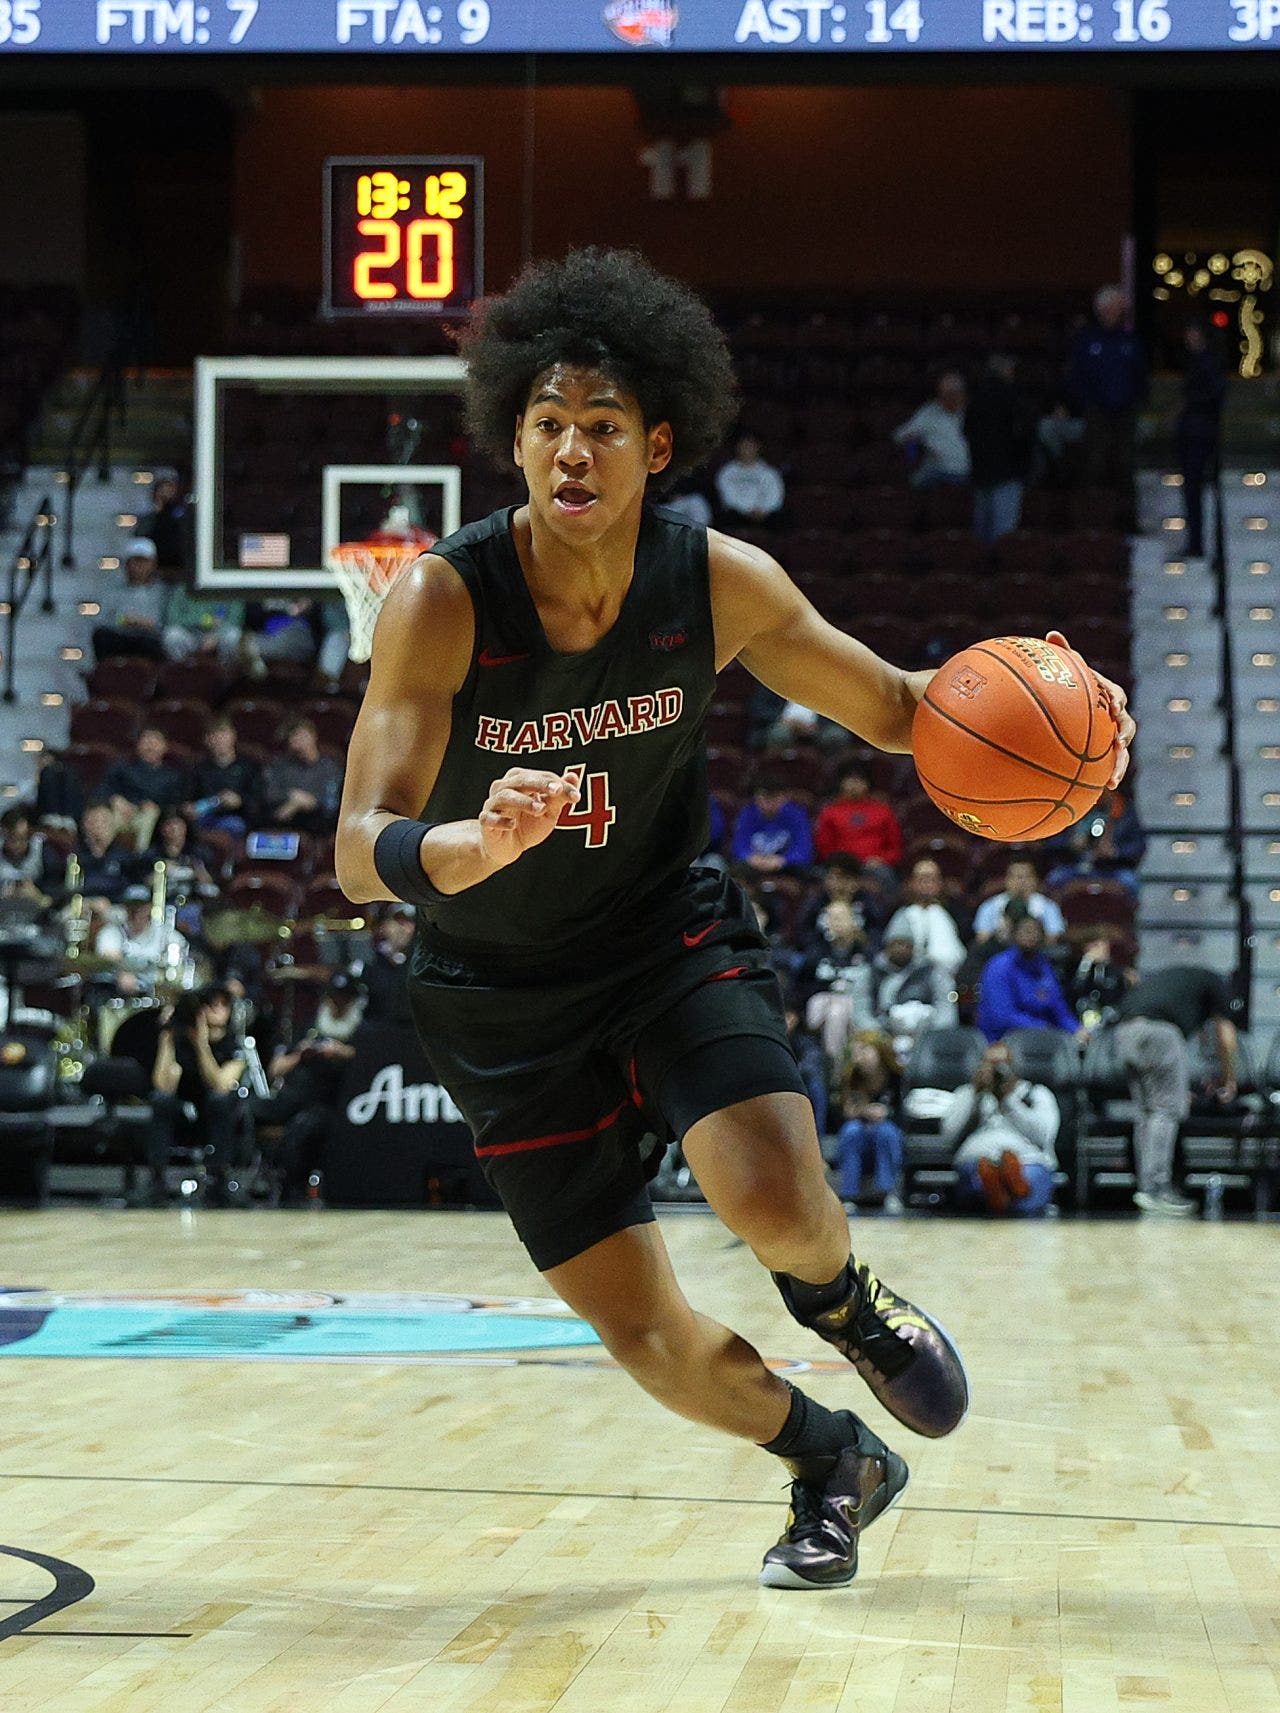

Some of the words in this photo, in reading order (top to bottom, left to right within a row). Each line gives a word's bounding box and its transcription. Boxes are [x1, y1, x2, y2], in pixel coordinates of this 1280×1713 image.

[97, 0, 210, 44] FTM:
[226, 0, 258, 44] 7
[336, 0, 442, 44] FTA:
[457, 0, 490, 43] 9
[734, 0, 847, 43] AST:
[865, 0, 924, 43] 14
[982, 0, 1094, 42] REB:
[1112, 0, 1172, 42] 16
[640, 138, 714, 200] 11
[354, 219, 454, 300] 20
[475, 686, 684, 755] HARVARD
[555, 763, 616, 849] 4
